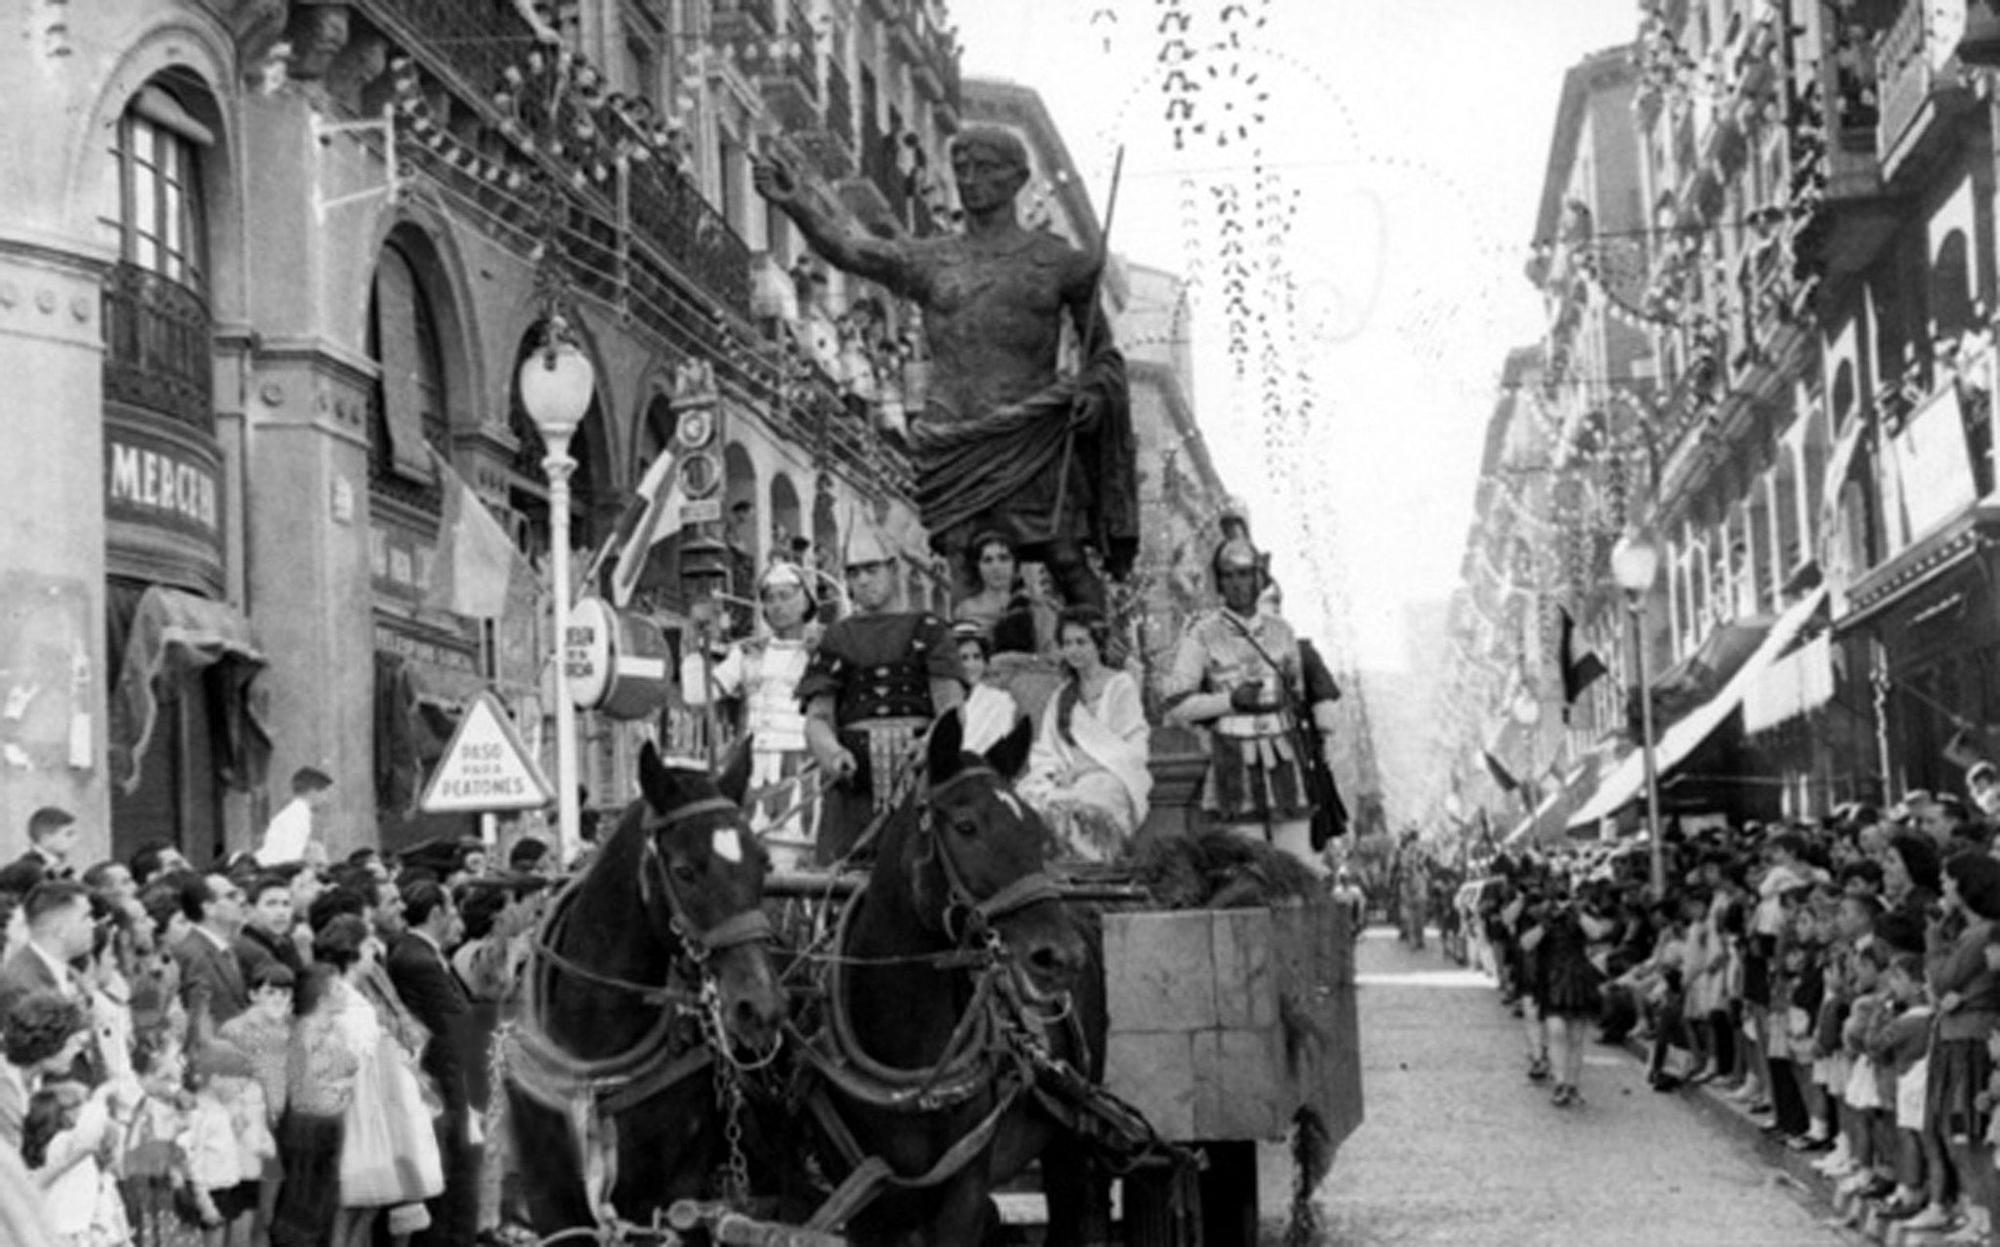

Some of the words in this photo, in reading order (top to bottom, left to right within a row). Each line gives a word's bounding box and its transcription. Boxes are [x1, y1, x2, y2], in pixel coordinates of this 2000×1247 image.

[461, 742, 502, 759] PASO
[462, 764, 502, 774] PARA
[442, 777, 525, 797] PEATONES
